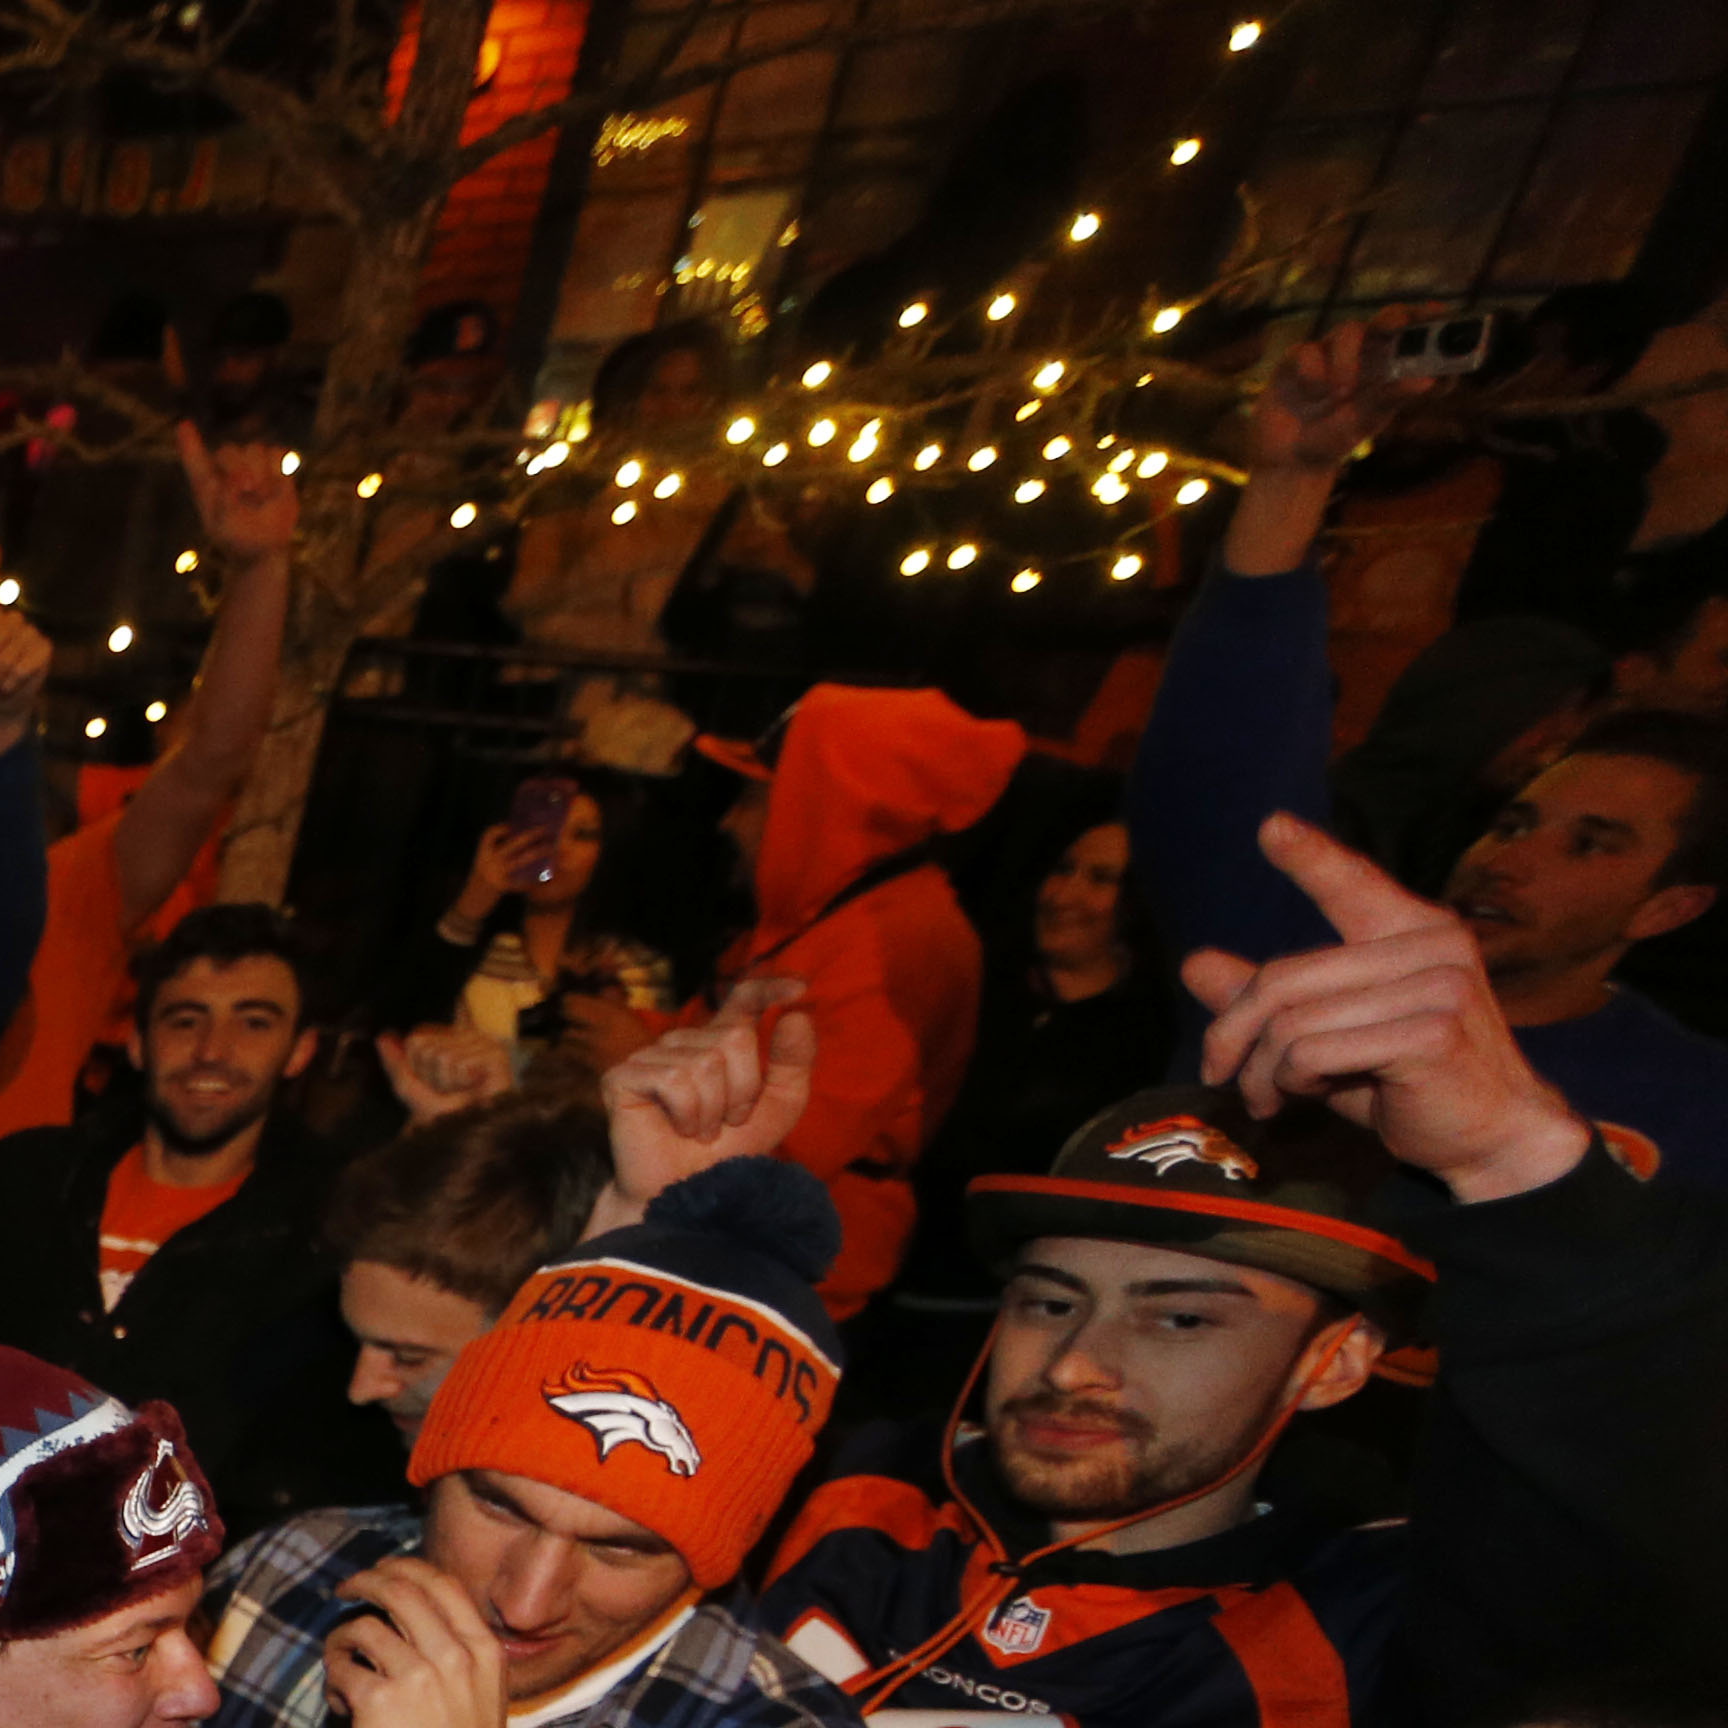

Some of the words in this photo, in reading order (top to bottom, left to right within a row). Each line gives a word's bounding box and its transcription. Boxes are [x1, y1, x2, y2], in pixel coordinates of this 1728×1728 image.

[520, 1275, 818, 1425] BRONCOS
[989, 1617, 1038, 1647] NFL
[888, 1649, 1051, 1715] ONCOS
